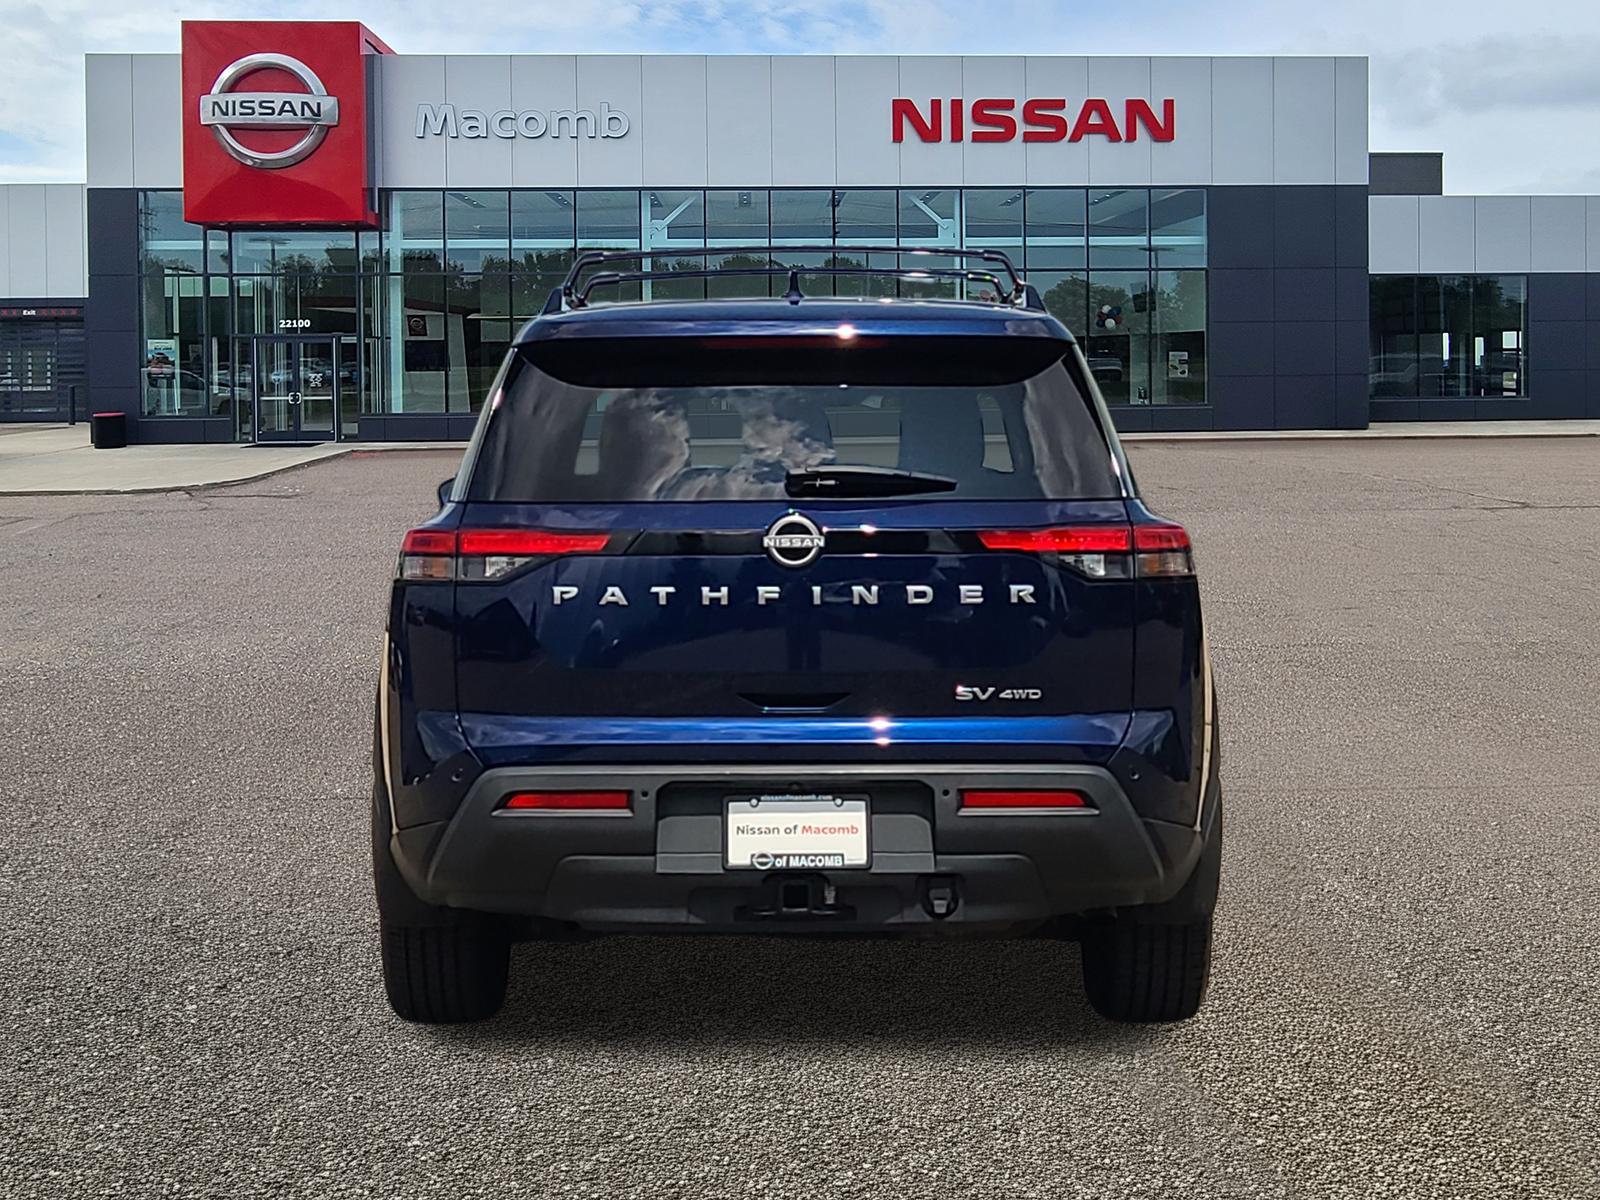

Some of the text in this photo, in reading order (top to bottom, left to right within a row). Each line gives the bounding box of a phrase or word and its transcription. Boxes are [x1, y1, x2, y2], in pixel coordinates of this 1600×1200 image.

[211, 100, 322, 118] NISSAN
[415, 102, 630, 139] Macomb
[892, 97, 1175, 143] NISSAN
[279, 319, 311, 328] 22100
[763, 536, 825, 548] NISSAN
[552, 585, 1037, 606] PATHFINDER
[955, 685, 1042, 700] SV 4WD
[736, 824, 859, 835] Nissan of Macomb
[775, 855, 843, 867] of MACOMB
